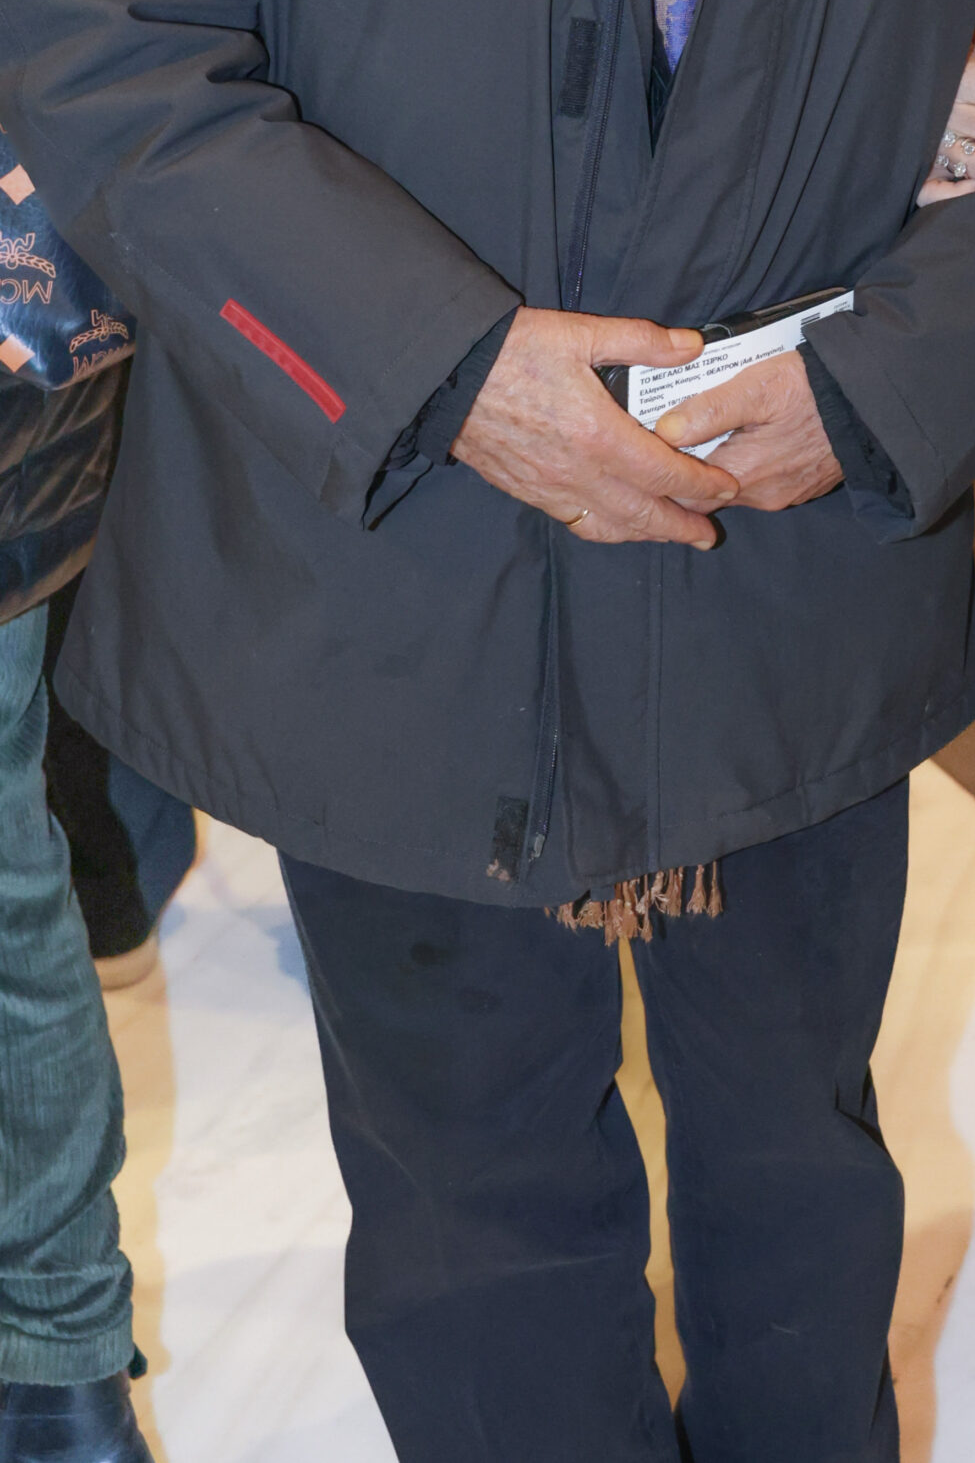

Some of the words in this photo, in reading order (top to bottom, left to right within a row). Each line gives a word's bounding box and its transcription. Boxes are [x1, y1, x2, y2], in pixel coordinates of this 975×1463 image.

[640, 377, 651, 385] ΤΟ
[652, 367, 683, 381] ΜΕΓΑΛΟ
[684, 361, 700, 372] ΜΑΣ
[702, 353, 729, 366] ΤΣΙΡΚΟ
[706, 361, 739, 376] ΘΕΑΤΡΟΝ
